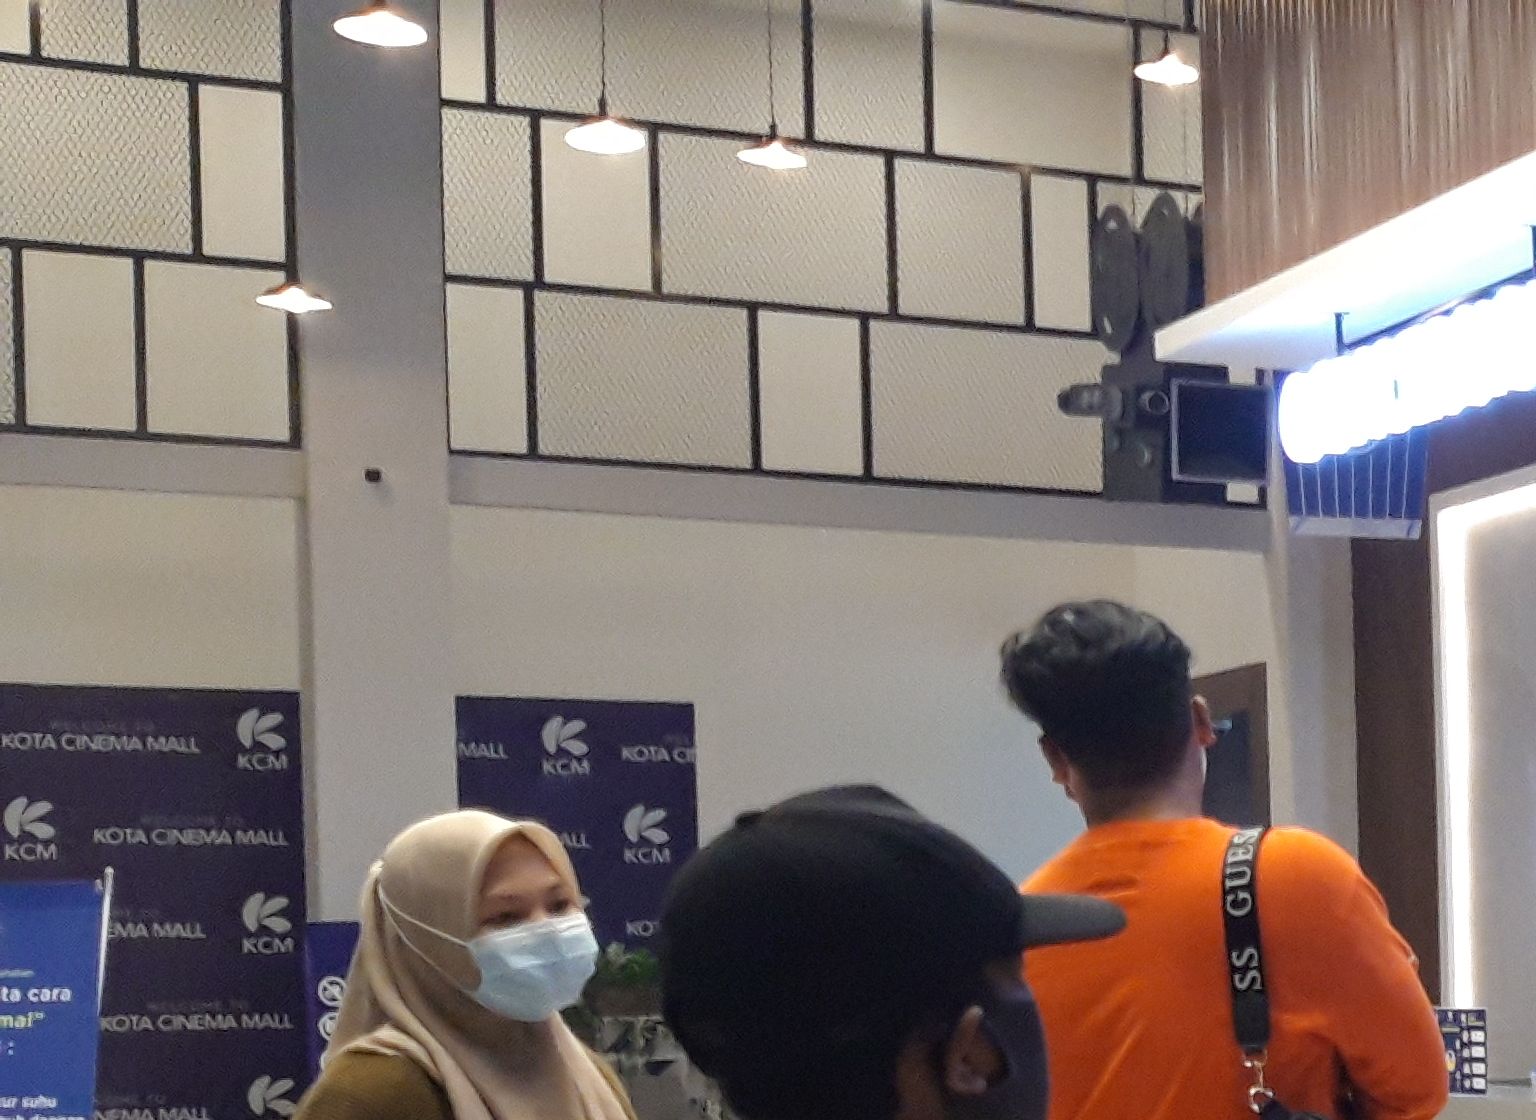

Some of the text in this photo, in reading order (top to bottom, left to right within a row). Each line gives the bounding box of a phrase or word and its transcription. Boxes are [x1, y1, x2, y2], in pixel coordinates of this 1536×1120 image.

[0, 732, 201, 754] KOTA CINEMA MALL
[236, 752, 288, 771] KCM
[621, 746, 670, 763] KOTA
[542, 758, 591, 776] KCM
[93, 827, 289, 847] KOTA CINEMA MALL
[4, 842, 58, 861] KCM
[624, 848, 671, 864] KCM
[152, 922, 207, 940] MALL
[242, 936, 294, 955] KCM
[28, 987, 72, 1003] cara
[101, 1012, 294, 1032] KOTA CINEMA MALL
